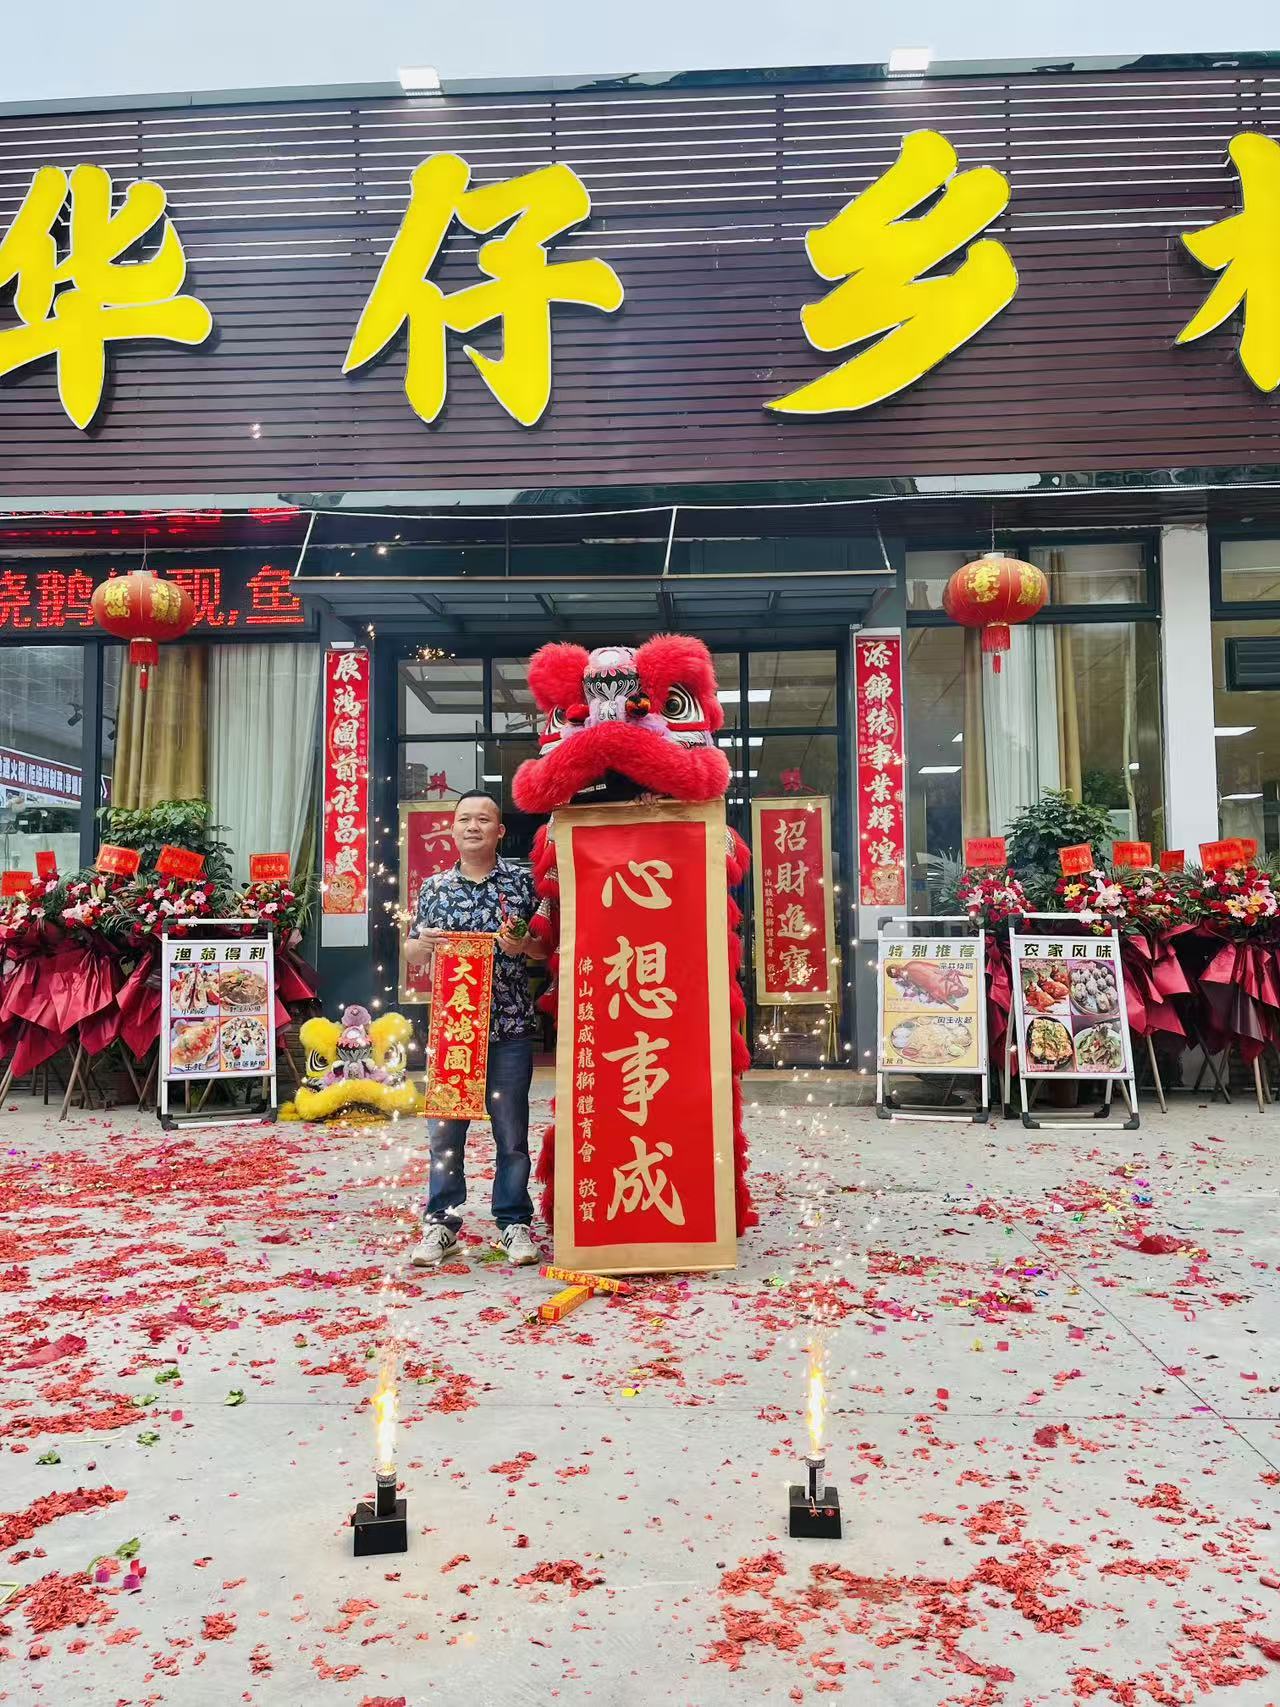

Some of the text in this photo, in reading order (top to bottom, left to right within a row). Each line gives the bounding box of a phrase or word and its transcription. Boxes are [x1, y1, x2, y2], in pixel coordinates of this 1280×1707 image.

[175, 947, 265, 961] 渔翁得利
[888, 944, 975, 958] 特别推荐
[1024, 943, 1112, 958] 农家风味
[601, 859, 686, 1226] 心想事成
